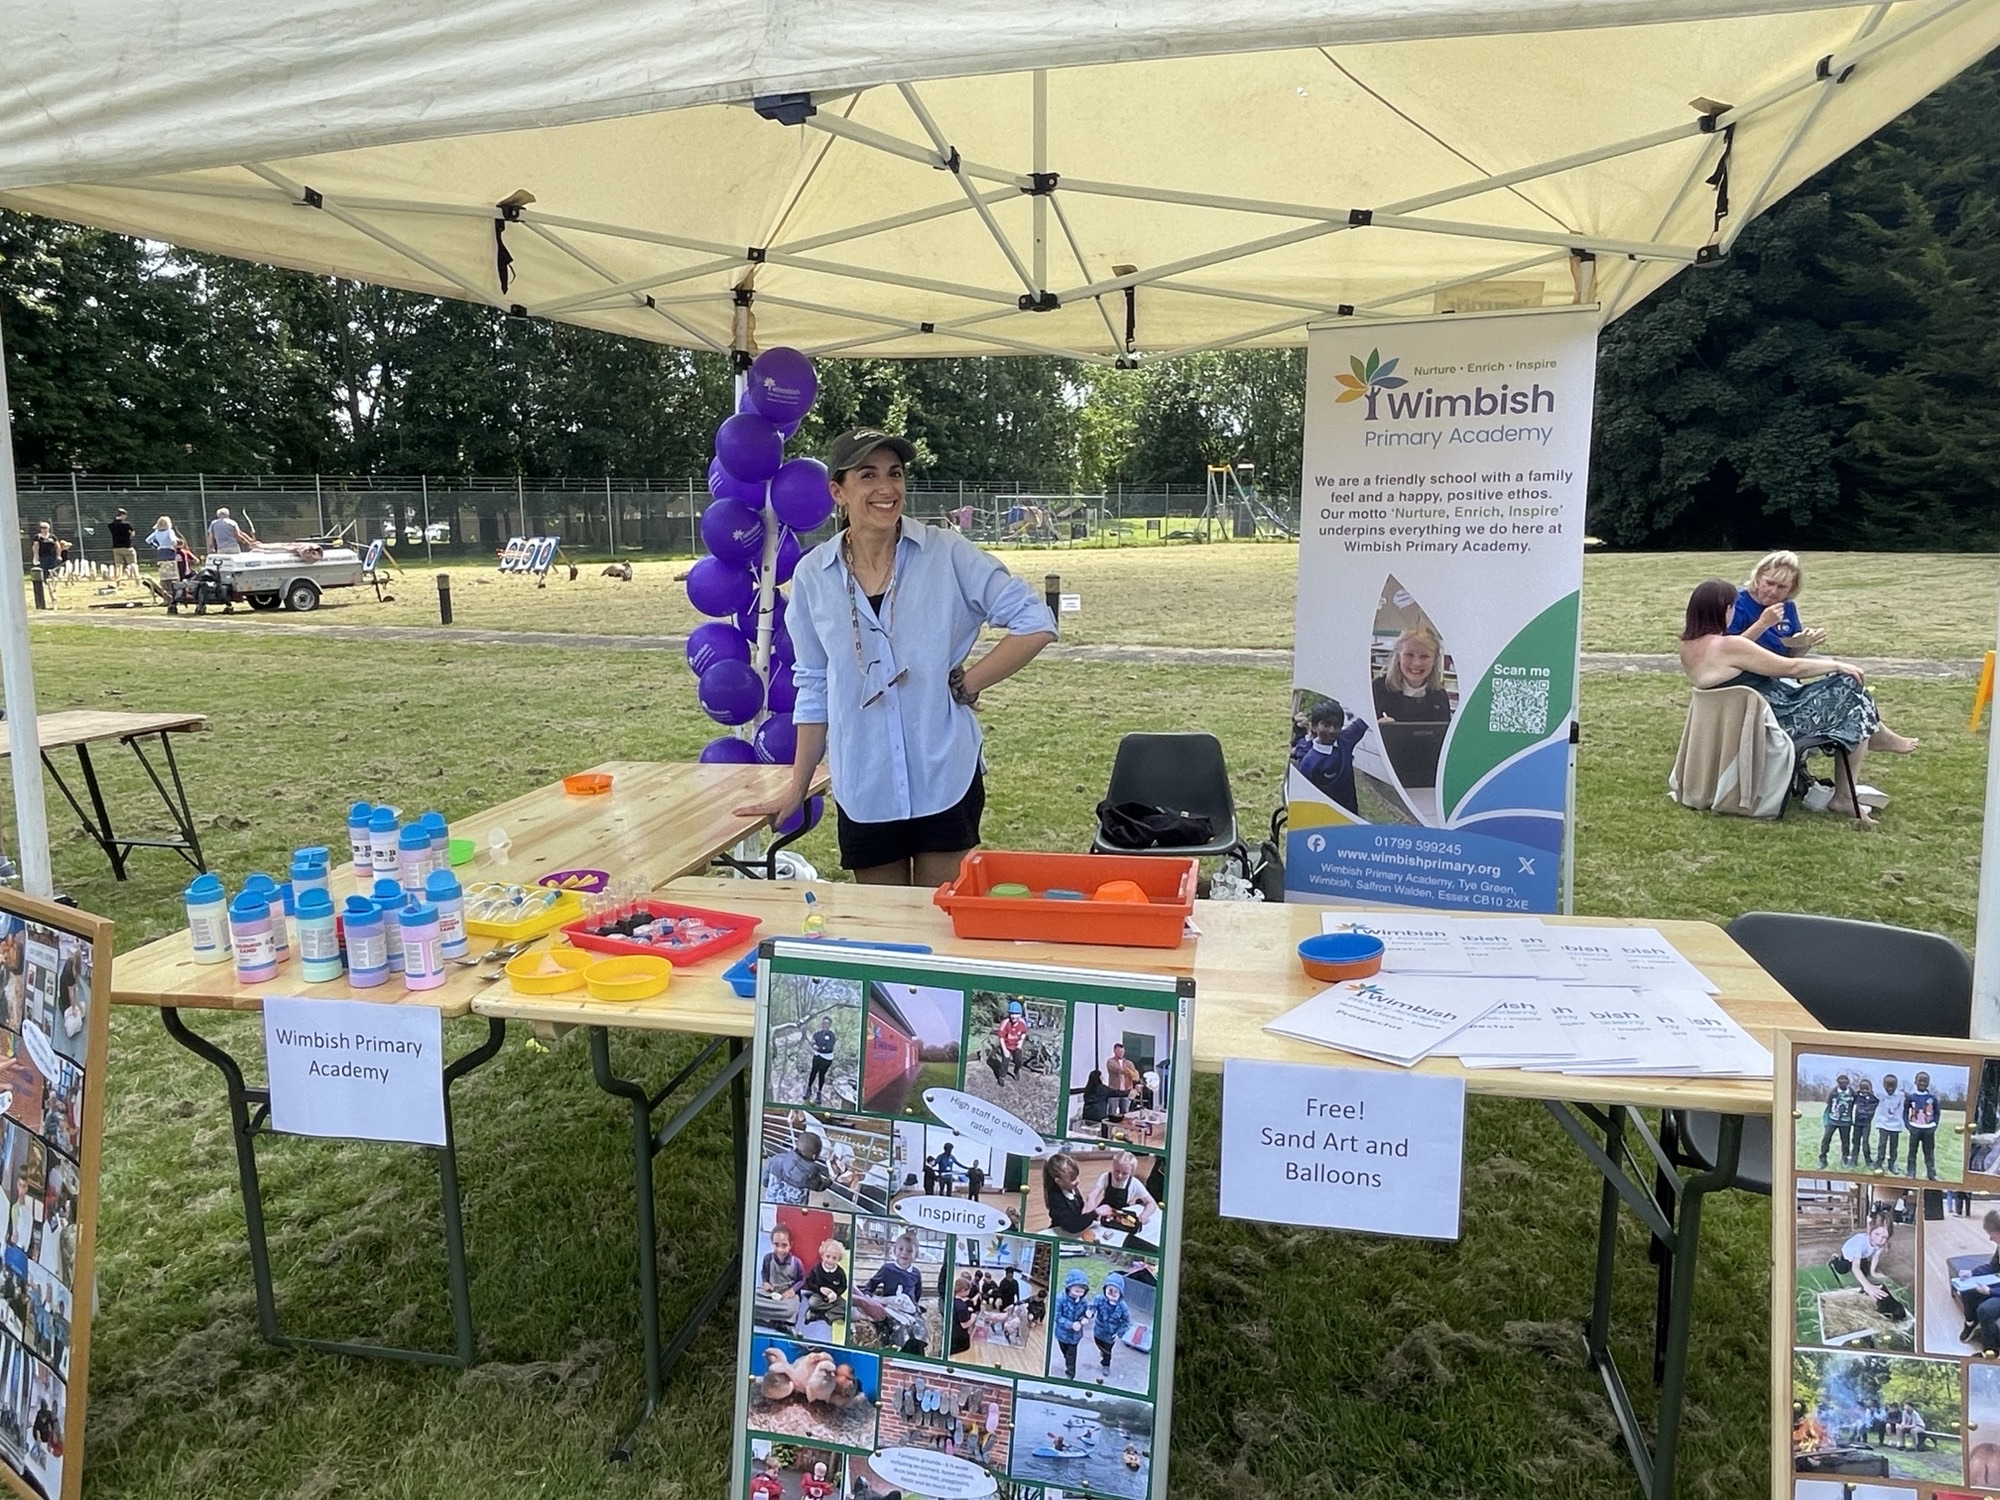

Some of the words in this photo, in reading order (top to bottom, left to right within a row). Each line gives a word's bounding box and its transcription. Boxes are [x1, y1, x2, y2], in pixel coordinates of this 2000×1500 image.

[1414, 366, 1456, 376] Nurture
[1467, 362, 1505, 373] Enrich
[1516, 359, 1557, 371] Inspire
[1387, 384, 1555, 420] Wimbish
[1365, 429, 1443, 450] Primary
[1449, 425, 1553, 446] Academy
[1315, 476, 1335, 487] We
[1339, 477, 1359, 487] are
[1363, 477, 1371, 486] a
[1375, 474, 1426, 488] friendly
[1430, 472, 1477, 485] school
[1481, 471, 1511, 483] with
[1515, 473, 1524, 482] a
[1528, 469, 1573, 484] family
[1331, 492, 1354, 503] feel
[1358, 492, 1383, 503] and
[1387, 493, 1395, 502] a
[1399, 491, 1443, 504] happy,
[1447, 488, 1504, 503] positive
[1507, 488, 1552, 500] ethos.
[1320, 508, 1345, 520] Our
[1349, 508, 1387, 519] motto
[1454, 506, 1504, 518] Enrich,
[1319, 525, 1386, 538] underpins
[1389, 523, 1461, 538] everything
[1465, 525, 1485, 535] we
[1489, 523, 1508, 535] do
[1512, 523, 1545, 534] here
[1548, 523, 1563, 534] at
[1344, 541, 1402, 552] Wimbish
[1406, 541, 1458, 555] Primary
[1462, 540, 1531, 555] Academy.
[1493, 663, 1527, 676] Scan
[1530, 667, 1550, 677] me
[1375, 835, 1413, 850] 01799
[1415, 840, 1462, 855] 599245
[1337, 849, 1501, 878] www.wimbishprimary.org
[1321, 863, 1362, 876] Wimbish
[1365, 868, 1403, 882] Primary
[1405, 873, 1455, 889] Academy,
[1458, 879, 1477, 891] Tye
[1480, 881, 1517, 896] Green,
[1309, 874, 1353, 889] Wimbish,
[1356, 880, 1391, 893] Saffron
[1394, 884, 1434, 899] Walden,
[1438, 890, 1470, 903] Essex
[1473, 894, 1503, 907] CB10
[1506, 898, 1529, 910] 2XE
[1362, 926, 1446, 937] Wimbish
[1460, 934, 1507, 942] bish
[1561, 945, 1608, 953] bish
[1621, 947, 1666, 955] bish
[1368, 993, 1458, 1020] Wimbish
[1590, 1011, 1640, 1019] bish
[1336, 1009, 1402, 1030] Prospectus
[276, 1028, 350, 1050] Wimbish
[355, 1034, 422, 1059] Primary
[308, 1060, 390, 1084] Academy
[950, 1095, 970, 1111] High
[971, 1106, 992, 1120] staff
[992, 1115, 1001, 1125] to
[1002, 1120, 1024, 1136] child
[1306, 1098, 1364, 1120] Free!
[970, 1120, 994, 1137] ratio!
[1261, 1127, 1316, 1150] Sand
[1323, 1132, 1359, 1153] Art
[1366, 1138, 1408, 1158] and
[1286, 1162, 1382, 1188] Balloons
[918, 1204, 986, 1229] Inspiring
